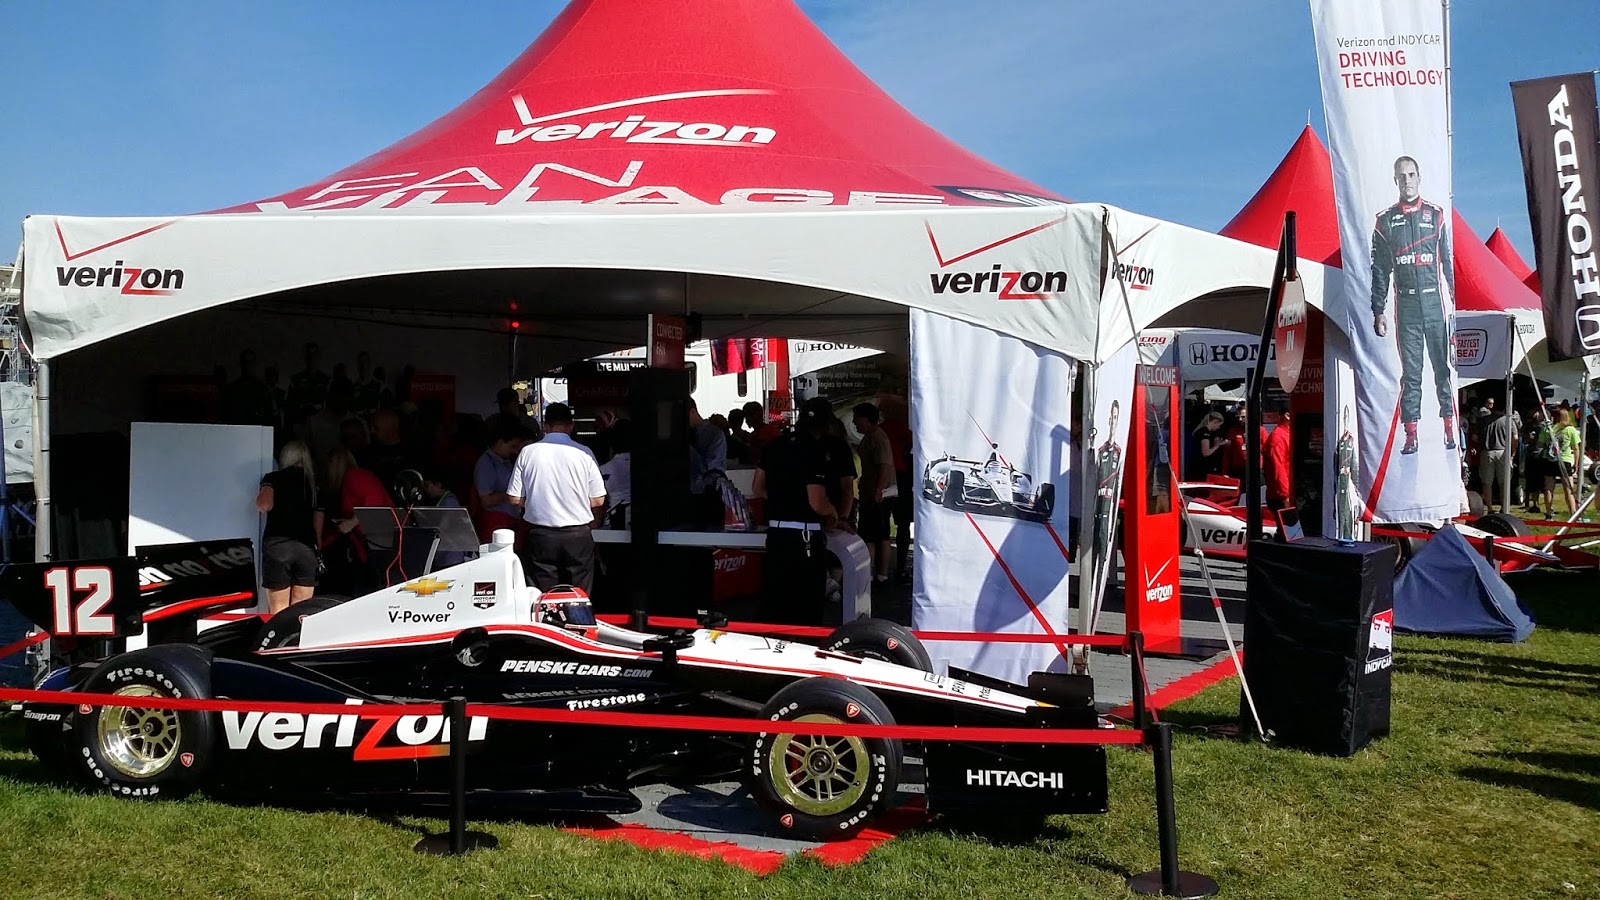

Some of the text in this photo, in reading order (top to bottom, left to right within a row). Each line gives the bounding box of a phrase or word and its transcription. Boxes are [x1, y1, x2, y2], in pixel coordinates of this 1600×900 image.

[1337, 34, 1441, 48] Verizon and INDYCAR
[1338, 50, 1407, 69] DRIVING
[1341, 70, 1443, 89] TECHNOLOGY
[495, 115, 777, 146] verizon
[304, 160, 645, 205] FAN
[1548, 84, 1600, 300] HONDA
[1396, 252, 1433, 266] verizon
[56, 260, 184, 295] verizon
[930, 264, 1068, 300] verizon
[1111, 258, 1154, 291] verizon
[810, 342, 861, 351] HOND
[1286, 330, 1295, 351] IN
[1456, 349, 1480, 358] SEAT
[596, 363, 612, 372] LTE
[1138, 366, 1176, 385] WELCOME
[44, 566, 116, 636] 12
[1146, 582, 1173, 602] verizon
[388, 610, 451, 623] V-Power
[107, 667, 182, 699] Fireston
[566, 692, 647, 712] Firestone
[24, 710, 62, 722] Snap-on
[222, 698, 489, 761] verizon
[966, 768, 1064, 789] HITACHI
